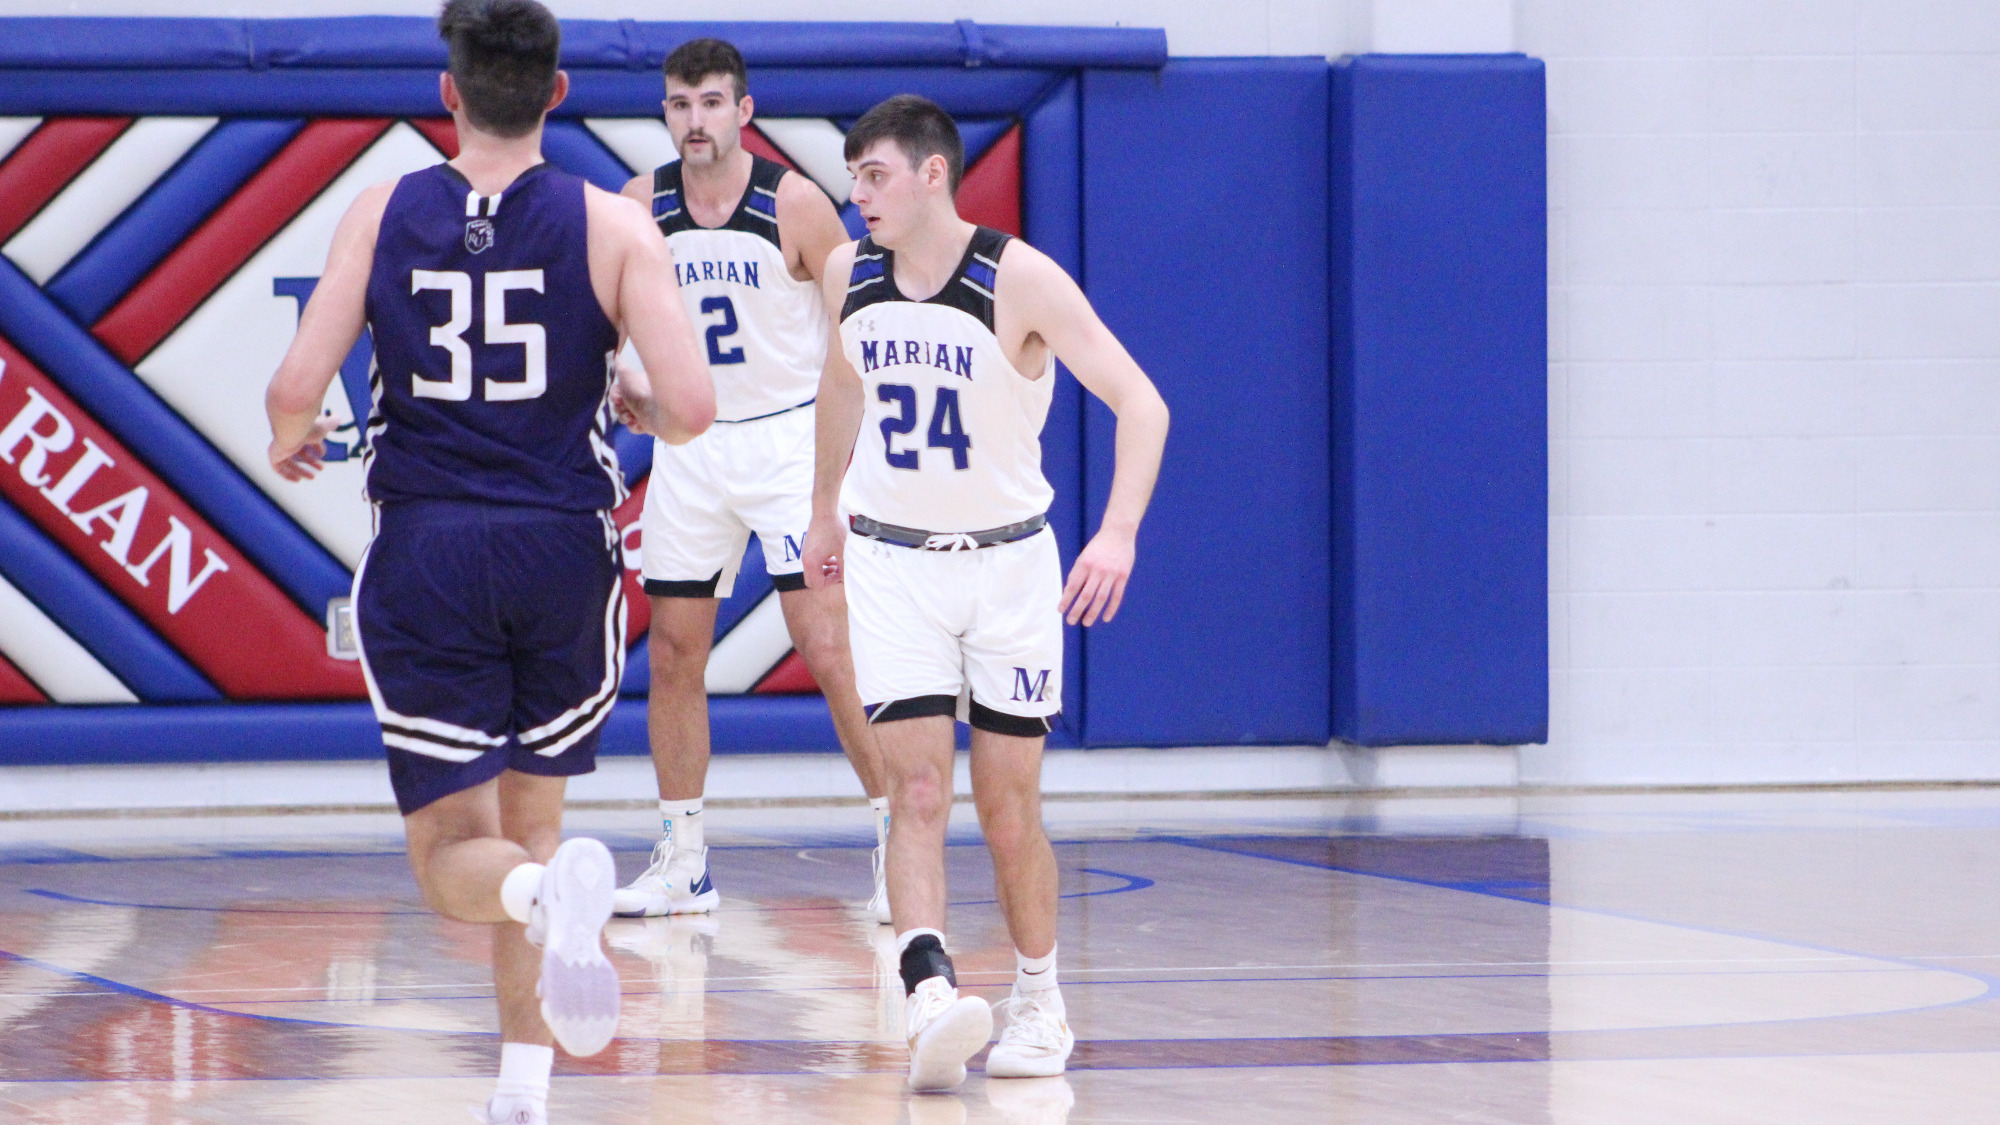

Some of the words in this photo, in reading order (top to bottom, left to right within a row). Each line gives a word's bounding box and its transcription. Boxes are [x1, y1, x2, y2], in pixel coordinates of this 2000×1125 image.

[411, 268, 547, 401] 35
[700, 296, 746, 366] 2
[860, 340, 974, 381] MARIAN
[876, 382, 973, 472] 24
[0, 358, 229, 615] RIAN
[1009, 666, 1052, 703] M
